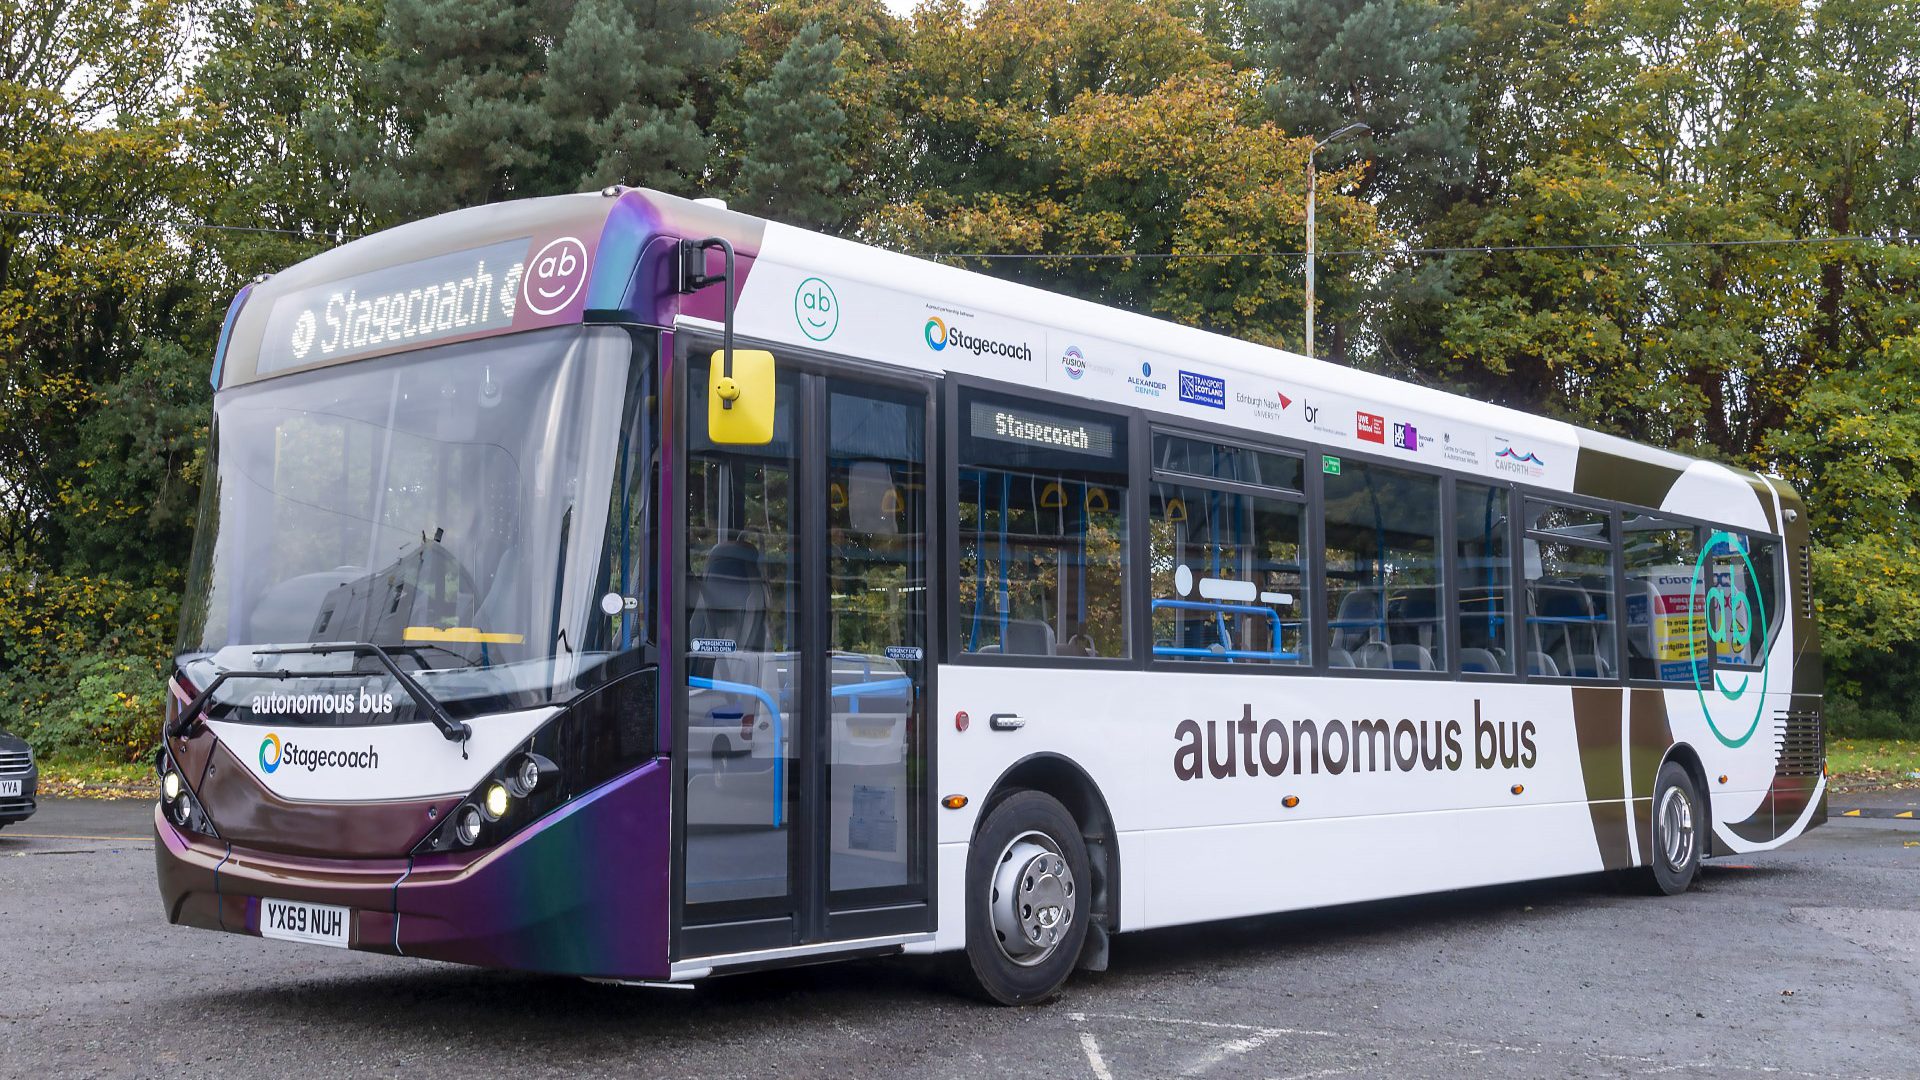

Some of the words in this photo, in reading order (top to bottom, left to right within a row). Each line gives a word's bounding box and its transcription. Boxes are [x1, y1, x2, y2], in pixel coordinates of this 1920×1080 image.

[539, 243, 576, 280] ab
[321, 260, 494, 354] Stagecoach
[804, 288, 830, 312] ab
[949, 327, 1032, 362] Stagecoach
[1062, 357, 1086, 369] FUSION
[1127, 376, 1167, 390] ALEXANDER
[1195, 376, 1223, 390] TRANSPORT
[1195, 385, 1223, 398] SCOTLAND
[1236, 393, 1262, 408] Edinburgh
[1263, 398, 1280, 410] Napier
[1254, 410, 1280, 420] UNIVERSITY
[1304, 398, 1318, 423] br
[1358, 413, 1369, 424] UWE
[995, 412, 1089, 449] Stagecoach
[1358, 422, 1373, 433] Bristol
[1394, 425, 1405, 437] UK
[1394, 434, 1405, 447] RI
[1419, 434, 1434, 443] Innovate
[1495, 459, 1529, 475] CAVFORTH
[252, 690, 354, 714] autonomous
[359, 686, 393, 714] bus
[1173, 703, 1463, 782] autonomous
[1474, 699, 1537, 770] bus
[282, 742, 379, 772] Stagecoach
[2, 781, 17, 793] YVA
[268, 903, 307, 932] YX69
[311, 908, 342, 937] NUH
